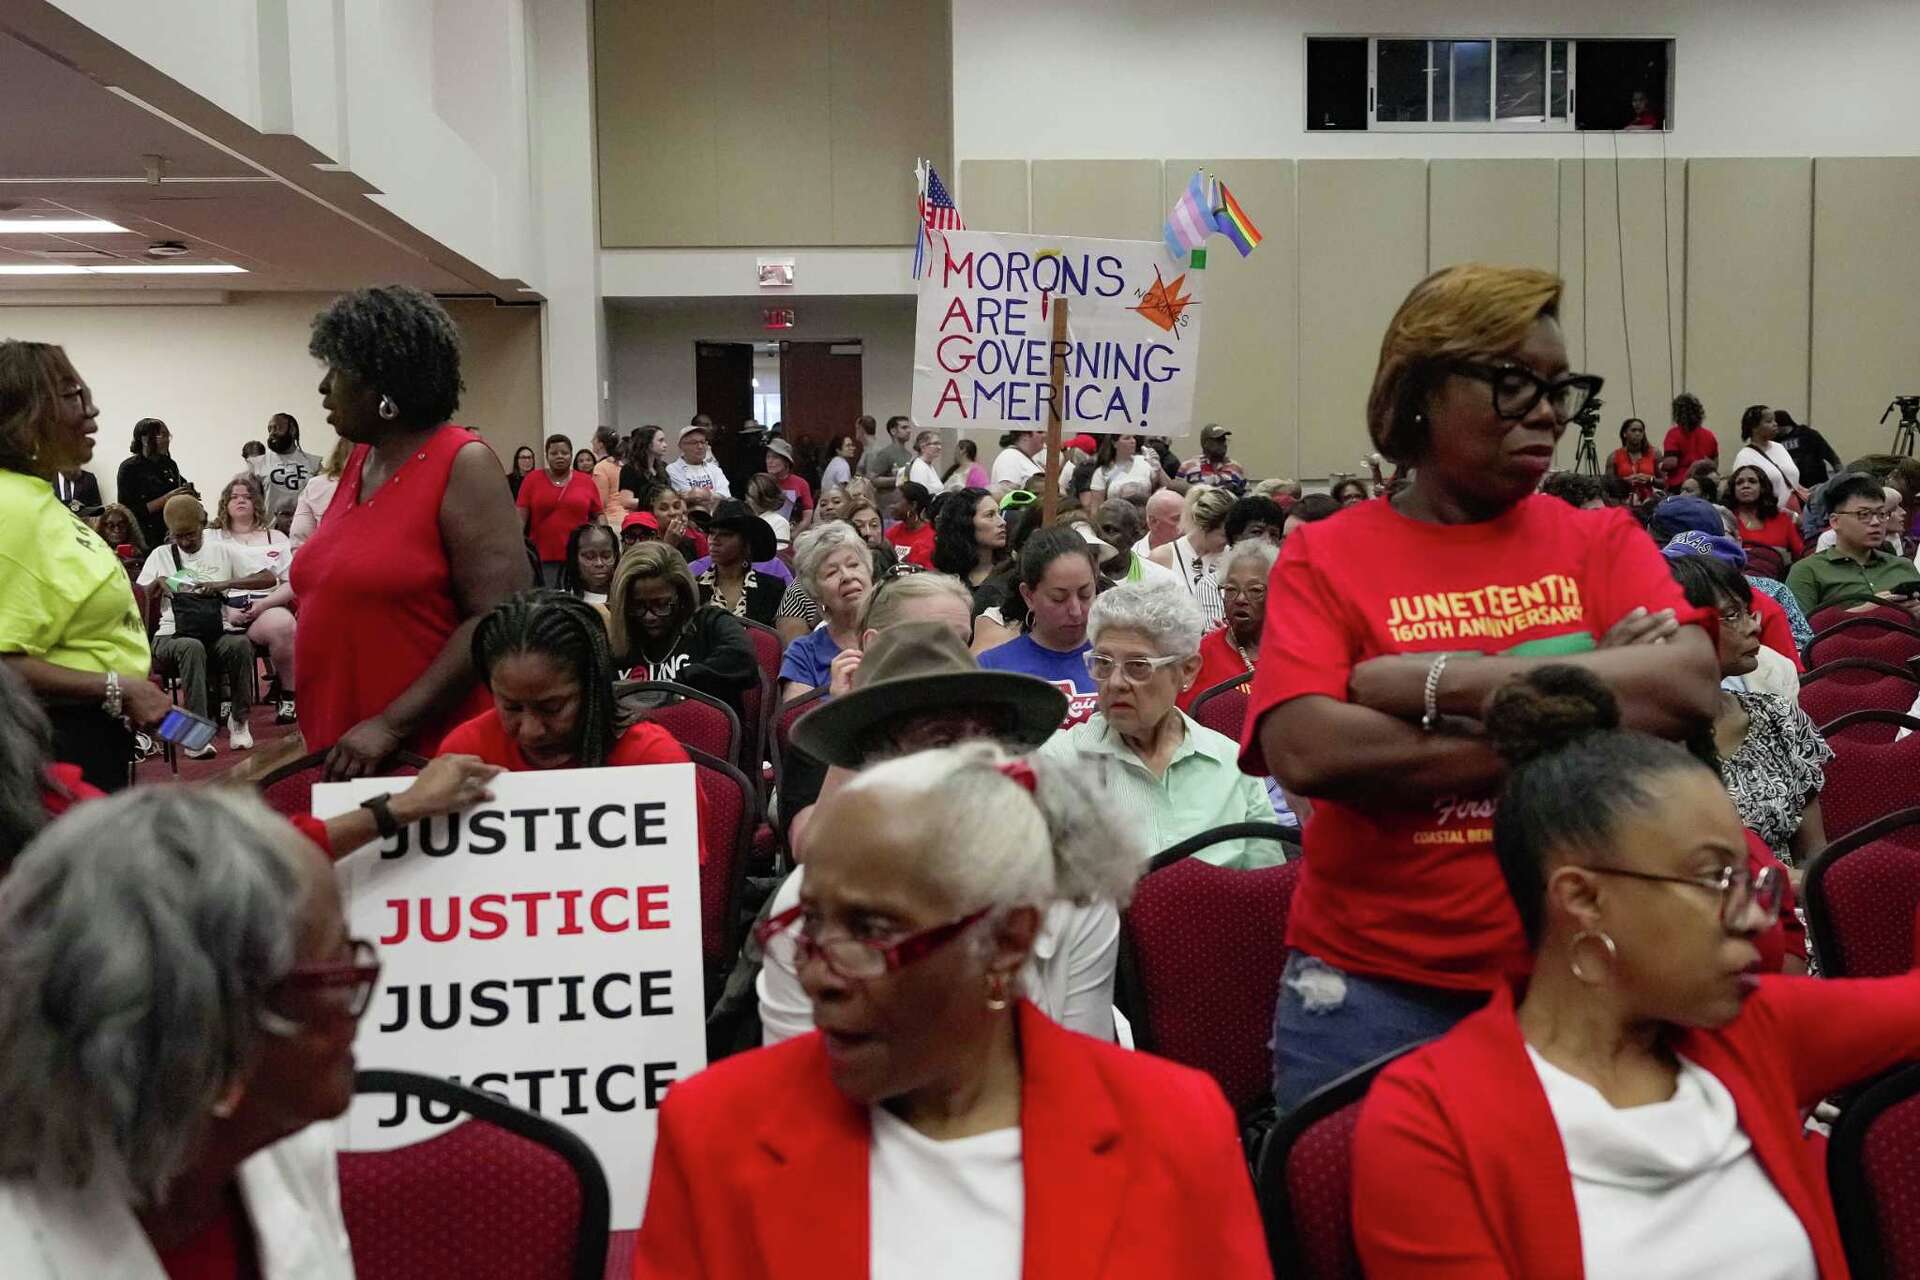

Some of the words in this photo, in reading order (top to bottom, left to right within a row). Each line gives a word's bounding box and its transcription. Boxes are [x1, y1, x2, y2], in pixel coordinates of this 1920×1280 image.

[943, 251, 1125, 297] MORONS
[939, 296, 1028, 336] ARE
[936, 334, 1181, 383] GOVERNING
[933, 378, 1150, 428] AMERICA!
[1387, 574, 1580, 626] JUNETEENTH
[1389, 620, 1454, 643] 160TH
[1458, 606, 1584, 639] ANNIVERSARY
[380, 802, 668, 860] JUSTICE
[1413, 830, 1466, 844] COASTAL
[380, 884, 671, 945] JUSTICE
[380, 969, 674, 1033] JUSTICE
